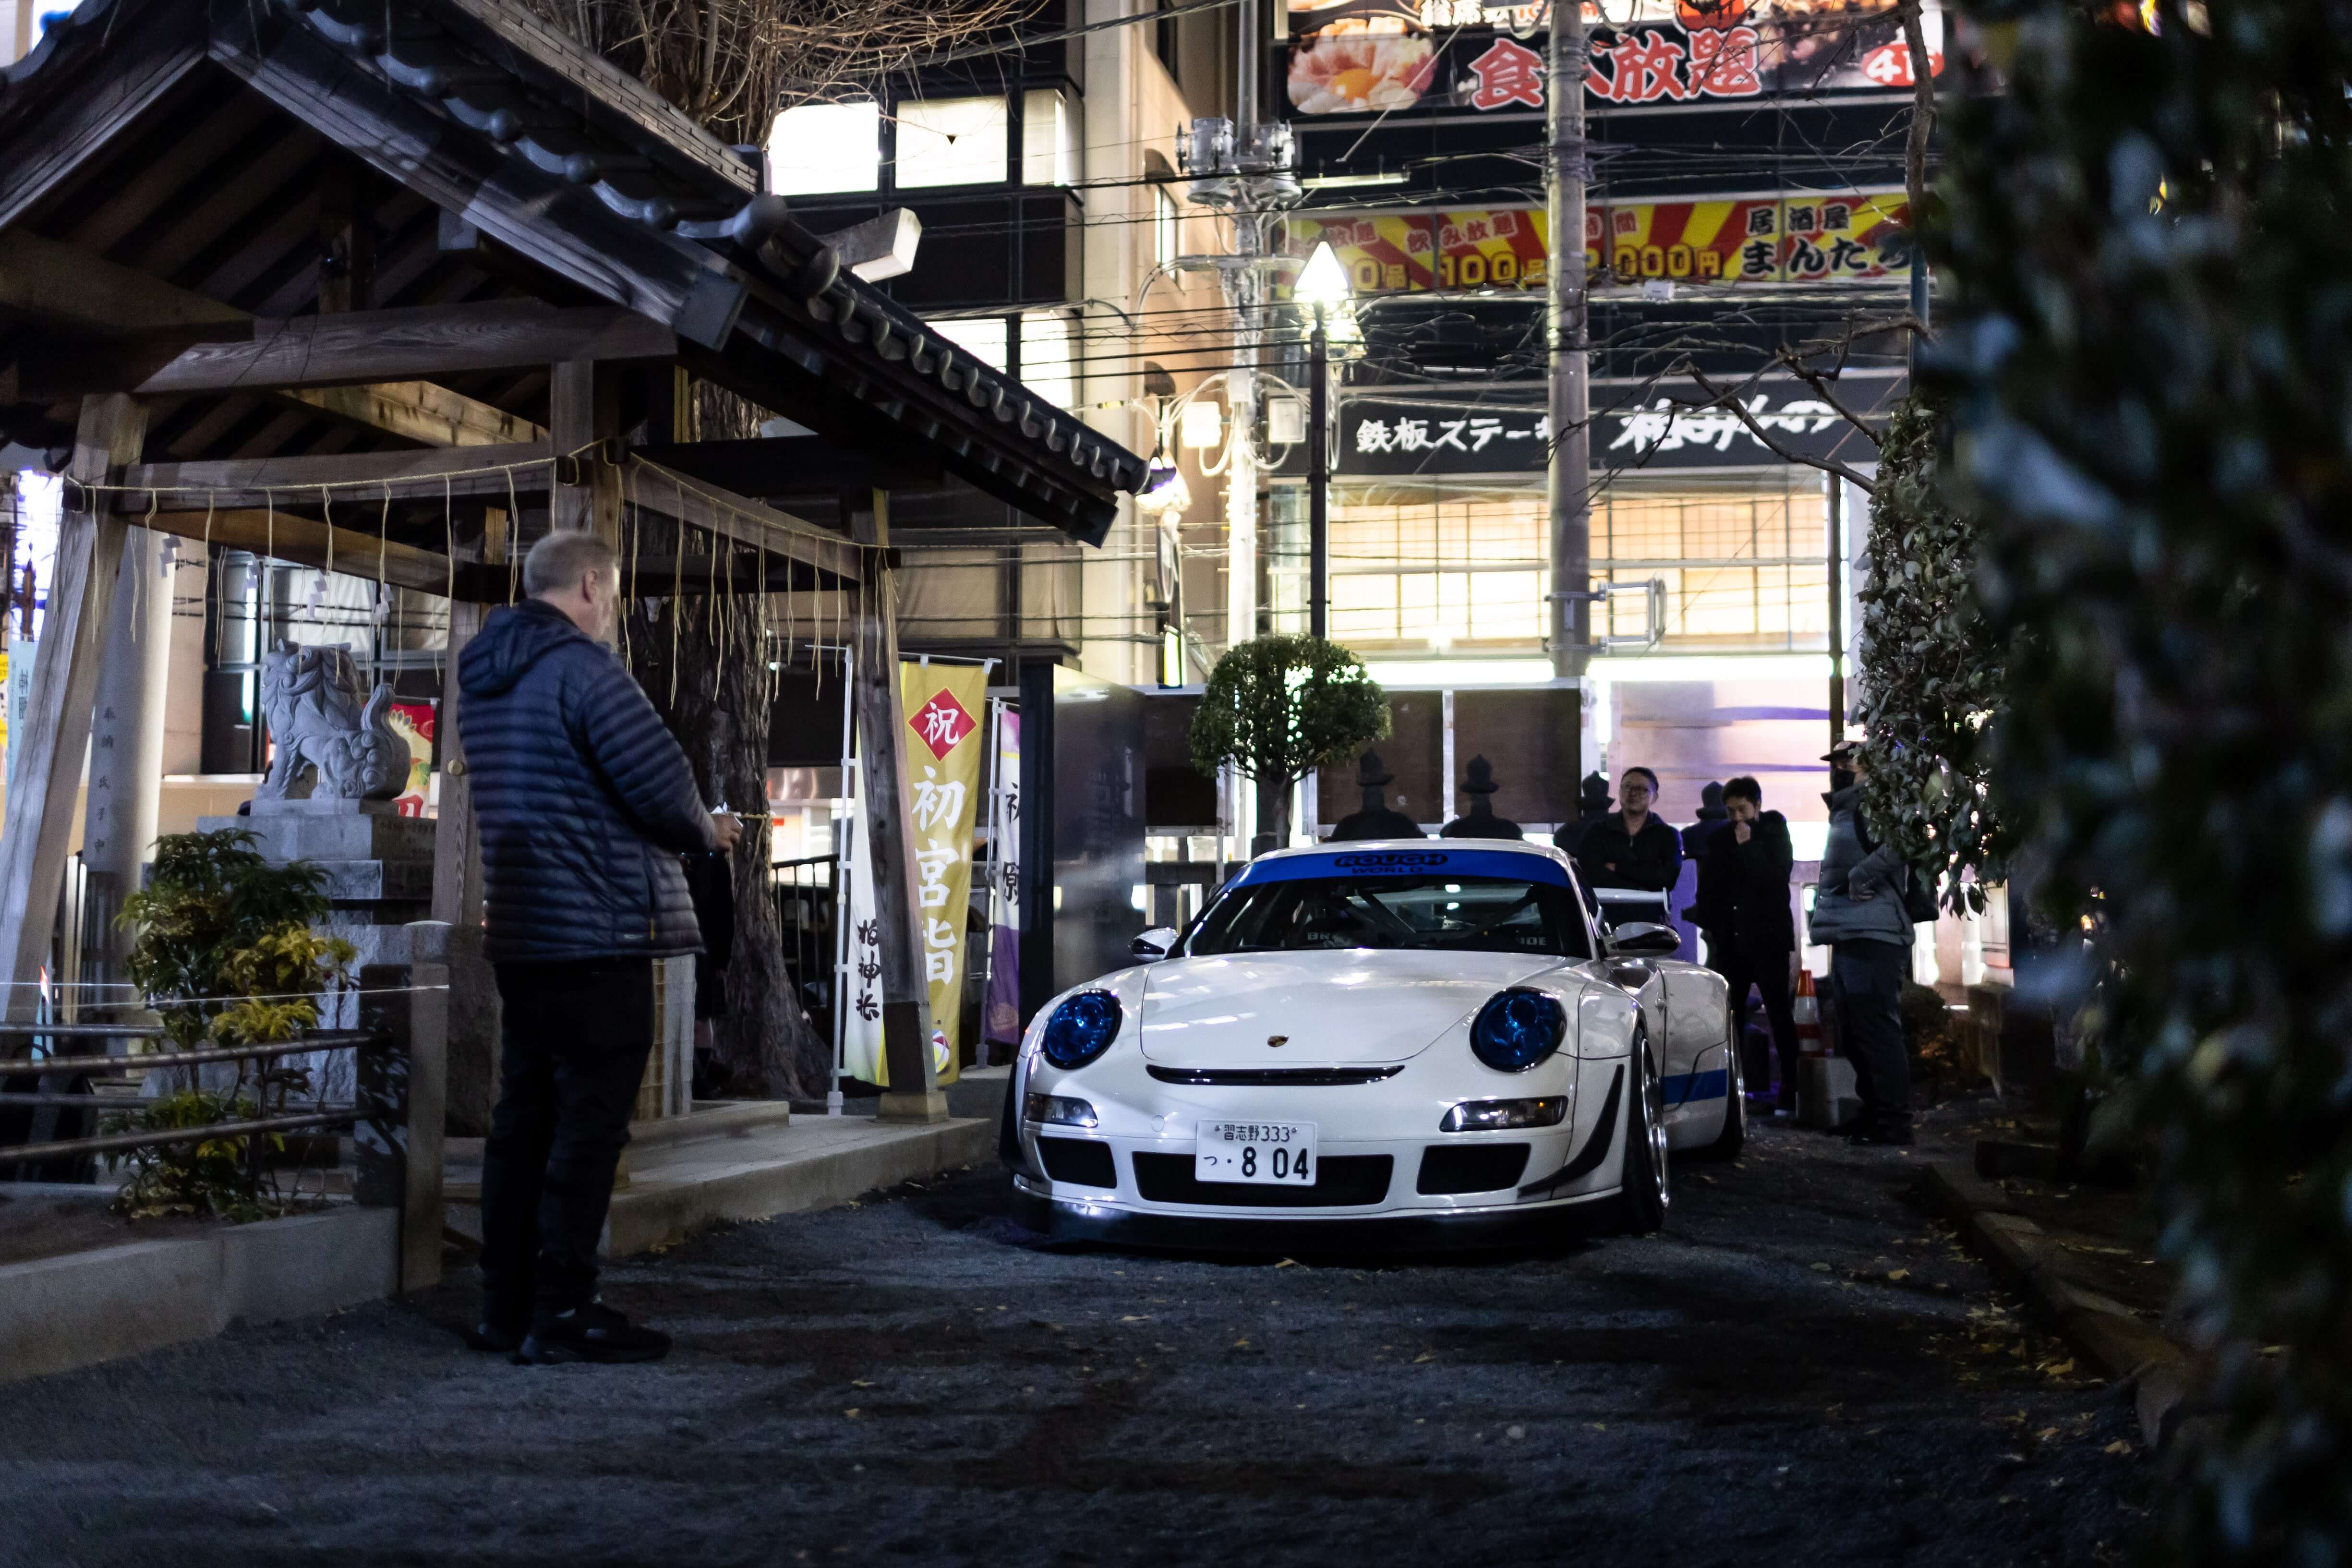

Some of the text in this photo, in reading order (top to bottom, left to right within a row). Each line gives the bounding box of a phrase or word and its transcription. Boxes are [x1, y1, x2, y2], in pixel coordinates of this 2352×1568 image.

[1747, 205, 1850, 234] 居酒屋
[923, 701, 959, 745] 祝
[1335, 854, 1447, 867] ROUGH
